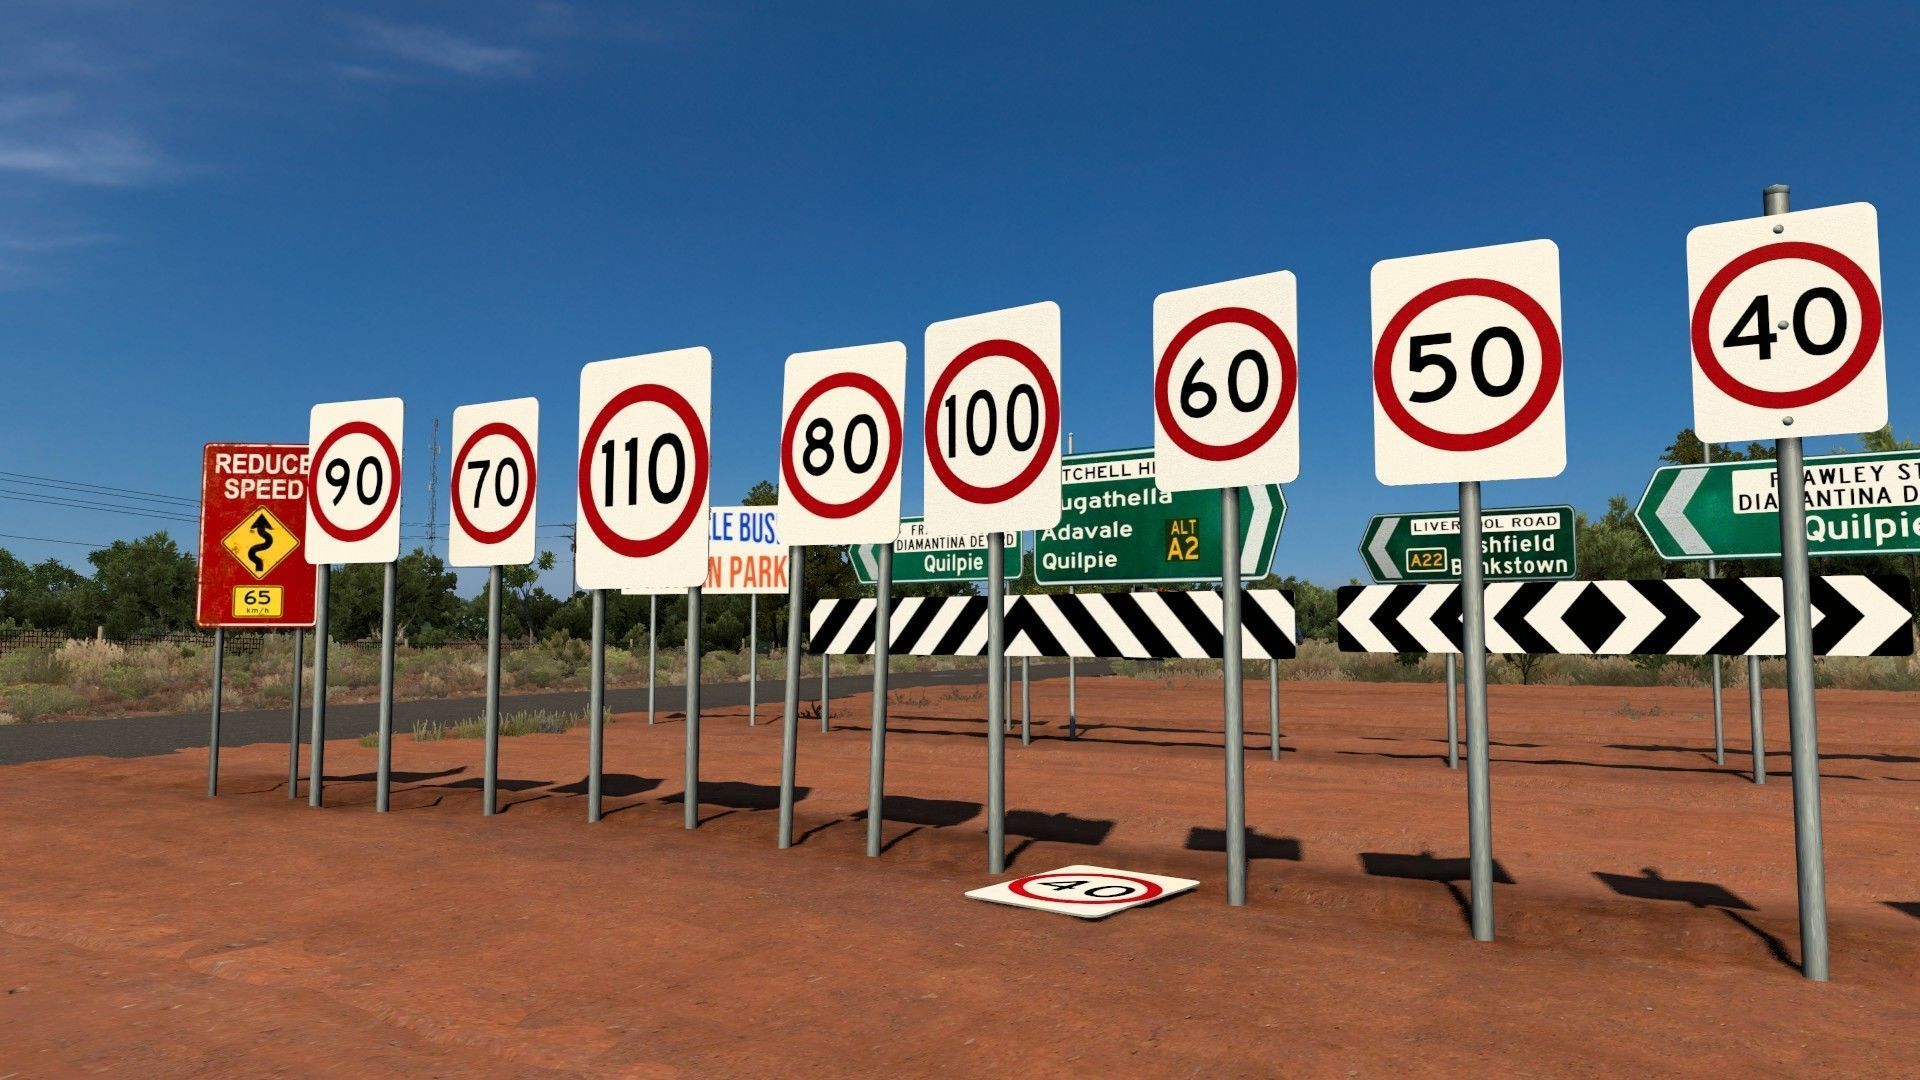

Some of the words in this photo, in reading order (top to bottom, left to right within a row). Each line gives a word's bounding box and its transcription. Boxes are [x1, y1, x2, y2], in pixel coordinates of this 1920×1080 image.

[1722, 286, 1847, 360] 40
[1408, 326, 1524, 403] 50
[1180, 349, 1269, 418] 60
[945, 383, 1039, 458] 100
[802, 413, 878, 476] 80
[215, 453, 309, 474] REDUCE
[600, 432, 686, 507] 110
[1062, 464, 1131, 481] TCHELL
[1138, 461, 1155, 475] HI
[325, 456, 383, 506] 90
[467, 457, 519, 508] 70
[1770, 464, 1884, 488] FAWLEY
[224, 478, 304, 499] SPEED
[1739, 486, 1892, 511] DIAANTINA
[1061, 488, 1173, 514] ugathella
[709, 512, 733, 541] LE
[739, 512, 780, 544] BUS
[1041, 522, 1133, 541] Adavale
[1171, 519, 1196, 535] ALT
[1512, 516, 1557, 528] ROAD
[896, 535, 966, 551] DIAMANTINA
[1167, 536, 1199, 561] A2
[1481, 534, 1555, 554] shfield
[730, 555, 788, 588] PARK
[924, 553, 984, 576] Quilpie
[1042, 551, 1118, 573] Quilpie
[1410, 553, 1443, 567] A22
[1451, 556, 1568, 576] Bnkstown
[244, 590, 271, 605] 65
[246, 607, 269, 617] km/h
[1037, 880, 1136, 898] 40
